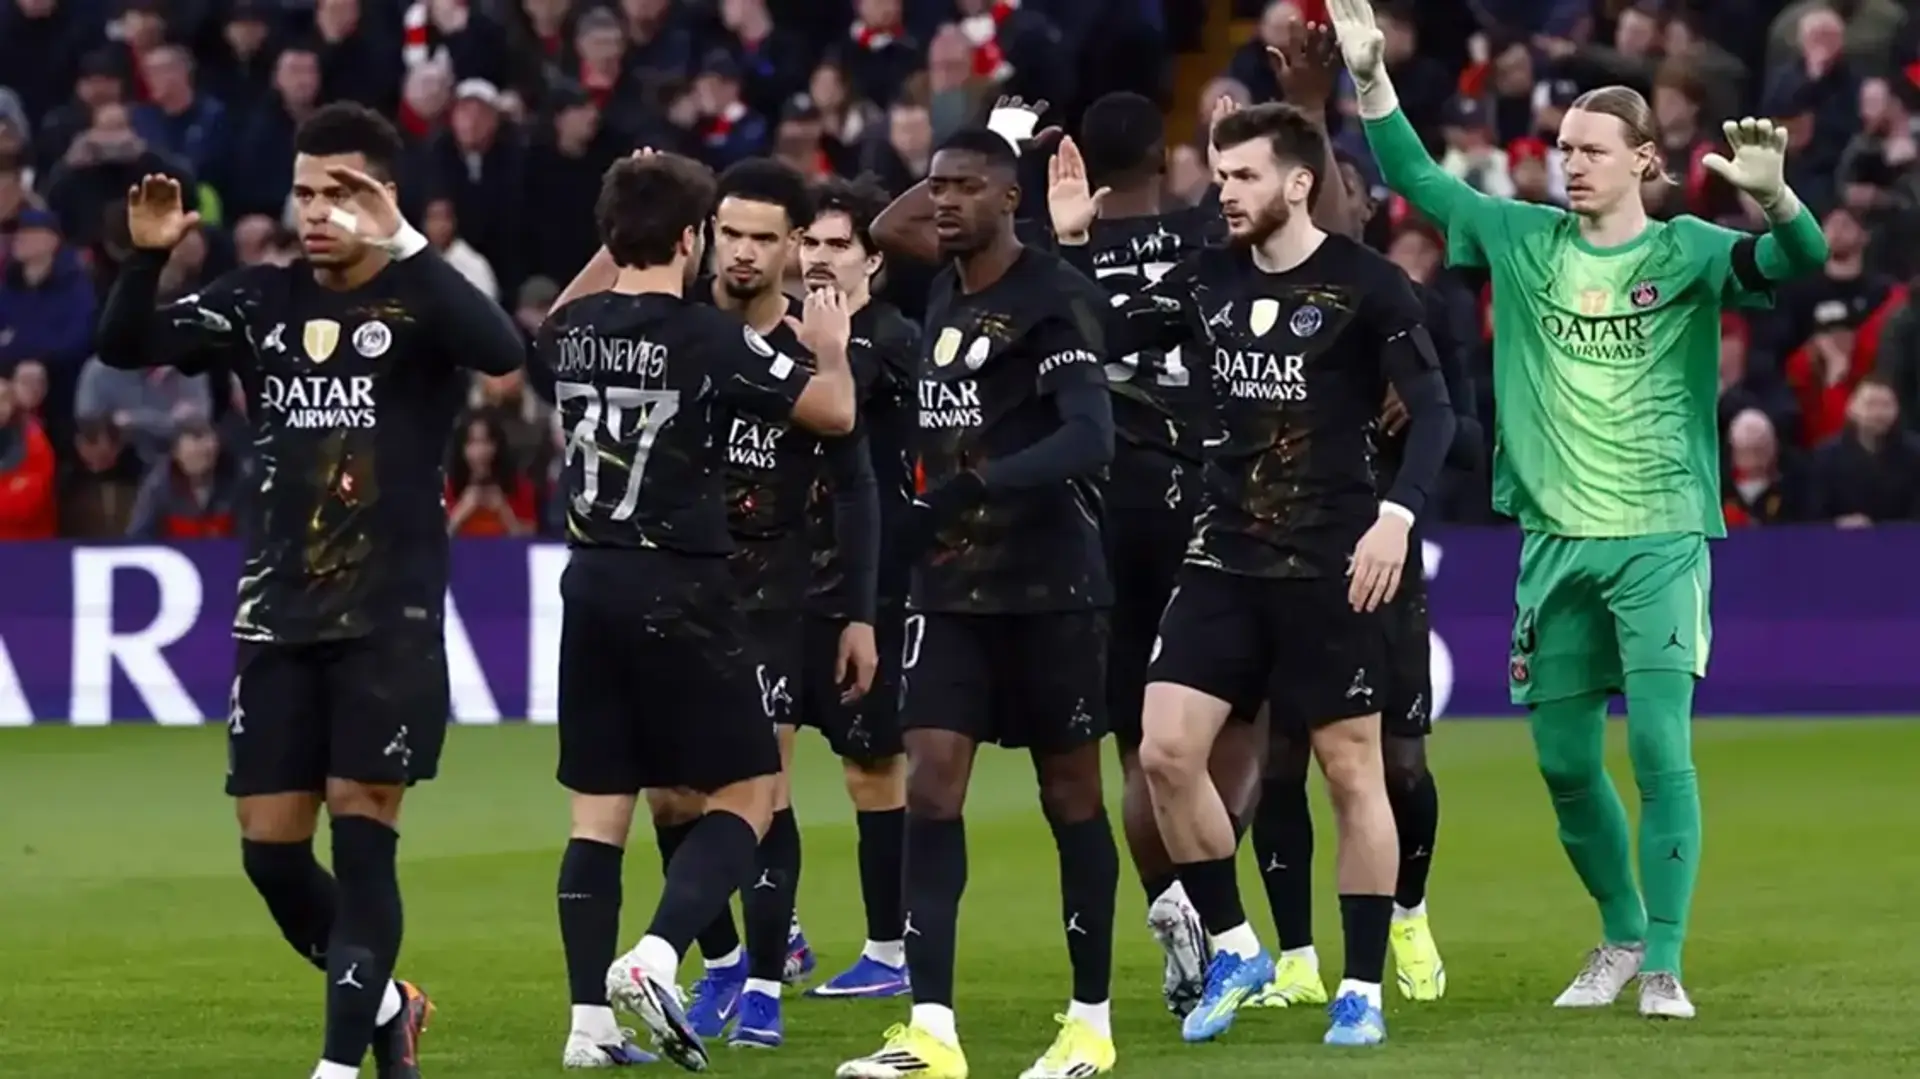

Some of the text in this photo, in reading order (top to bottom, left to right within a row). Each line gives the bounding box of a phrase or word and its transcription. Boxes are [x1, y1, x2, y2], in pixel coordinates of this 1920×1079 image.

[1542, 315, 1645, 341] QATAR
[599, 336, 668, 378] NEVES
[1563, 343, 1646, 360] AIRWAYS
[1211, 347, 1306, 383] QATAR
[262, 375, 376, 413] QATAR
[1230, 380, 1308, 401] AIRWAYS
[285, 409, 377, 428] AIRWAYS
[918, 407, 984, 430] IRWAYS
[728, 417, 785, 451] TAR
[728, 446, 777, 469] WAYS
